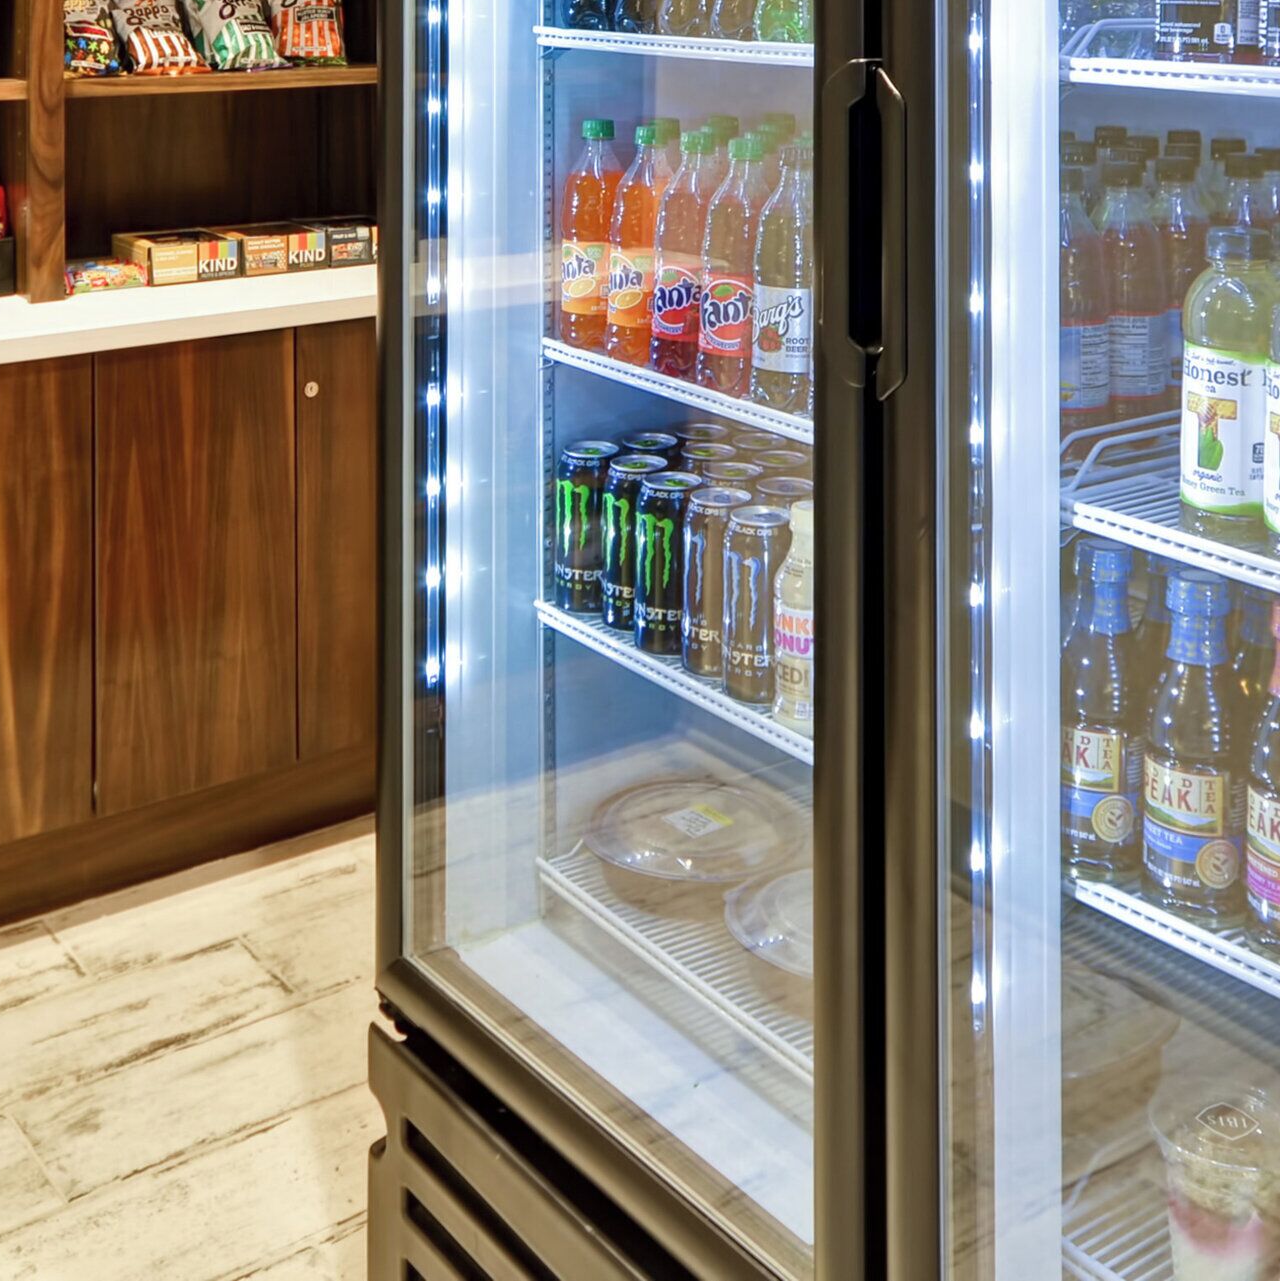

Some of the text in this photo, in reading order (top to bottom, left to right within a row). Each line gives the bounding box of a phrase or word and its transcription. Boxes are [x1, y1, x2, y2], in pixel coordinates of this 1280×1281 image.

[199, 257, 238, 274] KIND
[289, 248, 326, 265] KIND
[562, 254, 596, 282] anta
[700, 291, 753, 330] Fant
[1185, 358, 1251, 387] Honest
[1199, 482, 1246, 497] Green Tea
[1103, 738, 1114, 771] TEA
[1205, 780, 1217, 814] TEA
[1164, 830, 1183, 845] TEA
